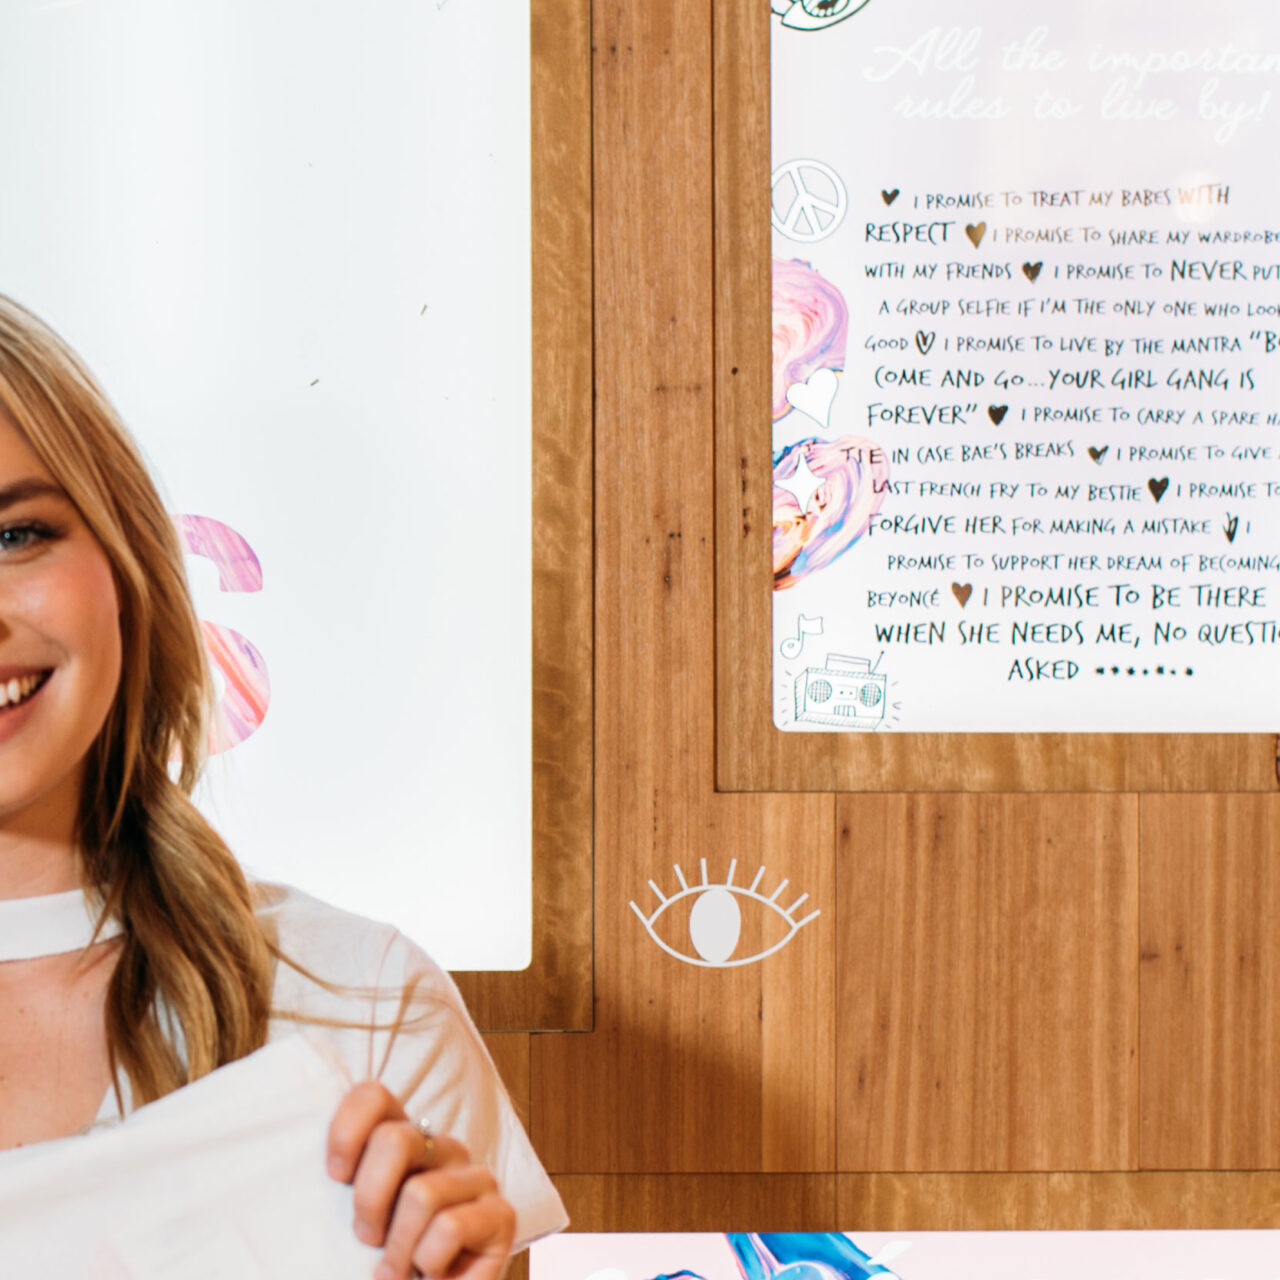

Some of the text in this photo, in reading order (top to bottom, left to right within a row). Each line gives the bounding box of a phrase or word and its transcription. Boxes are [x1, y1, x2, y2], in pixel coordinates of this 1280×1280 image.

[862, 26, 982, 82] All
[1000, 24, 1068, 72] the
[892, 74, 1272, 146] rules to live by!
[913, 182, 1230, 210] I PROMISE TO TREAT MY BABES WITH
[864, 220, 956, 246] RESPECT
[993, 228, 998, 242] I
[1006, 226, 1074, 244] PROMISE
[1080, 226, 1102, 242] TO
[1108, 228, 1160, 246] SHARE
[1166, 230, 1191, 244] MY
[864, 262, 904, 279] WITH
[912, 263, 938, 279] MY
[946, 262, 1012, 280] FRIENDS
[1054, 265, 1058, 278] I
[1066, 262, 1134, 280] PROMISE
[1140, 262, 1162, 279] TO
[1170, 258, 1248, 282] NEVER
[878, 300, 890, 315] A
[896, 298, 950, 316] GROUP
[958, 298, 1012, 318] SELFIE
[1018, 298, 1036, 318] IF
[1040, 297, 1066, 314] I'M
[1073, 298, 1106, 316] THE
[1112, 300, 1156, 316] ONLY
[1162, 300, 1197, 318] ONE
[1204, 302, 1240, 317] WHO
[864, 334, 908, 352] GOOD
[944, 337, 948, 350] I
[956, 336, 1025, 352] PROMISE
[1030, 334, 1054, 350] TO
[1060, 336, 1097, 352] LIVE
[1104, 338, 1124, 357] BY
[1130, 338, 1164, 354] THE
[1172, 336, 1242, 354] MANTRA
[874, 366, 932, 389] COME
[940, 368, 985, 388] AND
[1110, 368, 1158, 390] GIRL
[1166, 368, 1230, 390] GANG
[1240, 368, 1255, 390] IS
[1022, 408, 1026, 421] I
[1034, 406, 1102, 424] PROMISE
[1108, 406, 1130, 422] TO
[1137, 408, 1186, 425] CARRY
[1192, 410, 1203, 424] A
[1211, 410, 1260, 425] SPARE
[840, 440, 1272, 464] TIE IN CASE BAE'S BREAKS I PROMISE TO GIVE
[872, 478, 915, 496] LAST
[920, 480, 981, 498] FRENCH
[990, 481, 1019, 499] FRY
[1026, 482, 1048, 499] TO
[1055, 484, 1080, 500] MY
[1088, 484, 1142, 502] BESTIE
[1177, 484, 1181, 497] I
[1189, 481, 1256, 499] PROMISE
[868, 512, 1250, 536] FORGIVE HER FOR MAKING A MISTAKE I
[888, 553, 1280, 573] PROMISE TO SUPPORT HER DREAM OF BECOMING
[866, 583, 1266, 610] BEYONCÉ I PROMISE TO BE THERE
[874, 620, 946, 645] WHEN
[958, 620, 1000, 645] SHE
[1011, 620, 1084, 645] NEEDS
[1095, 622, 1140, 648] ME,
[1154, 622, 1186, 645] NO
[1008, 656, 1078, 681] ASKED
